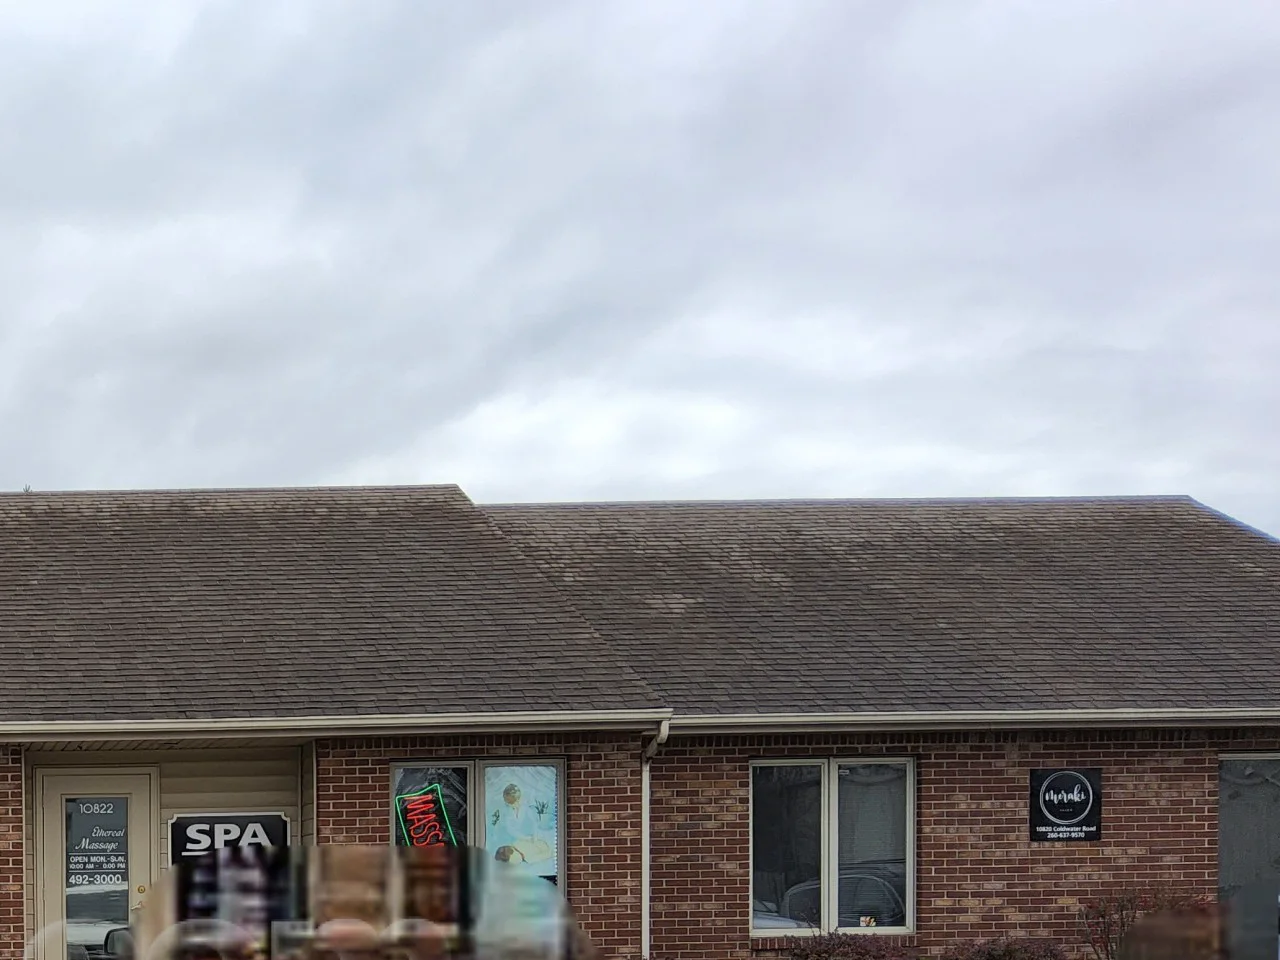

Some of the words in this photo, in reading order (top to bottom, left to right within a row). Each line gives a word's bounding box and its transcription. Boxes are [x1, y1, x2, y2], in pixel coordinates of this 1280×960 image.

[79, 803, 114, 814] 10822
[91, 826, 125, 837] Ethereal
[185, 823, 273, 850] SPA
[74, 837, 119, 853] Massage
[68, 874, 122, 885] 492-3000
